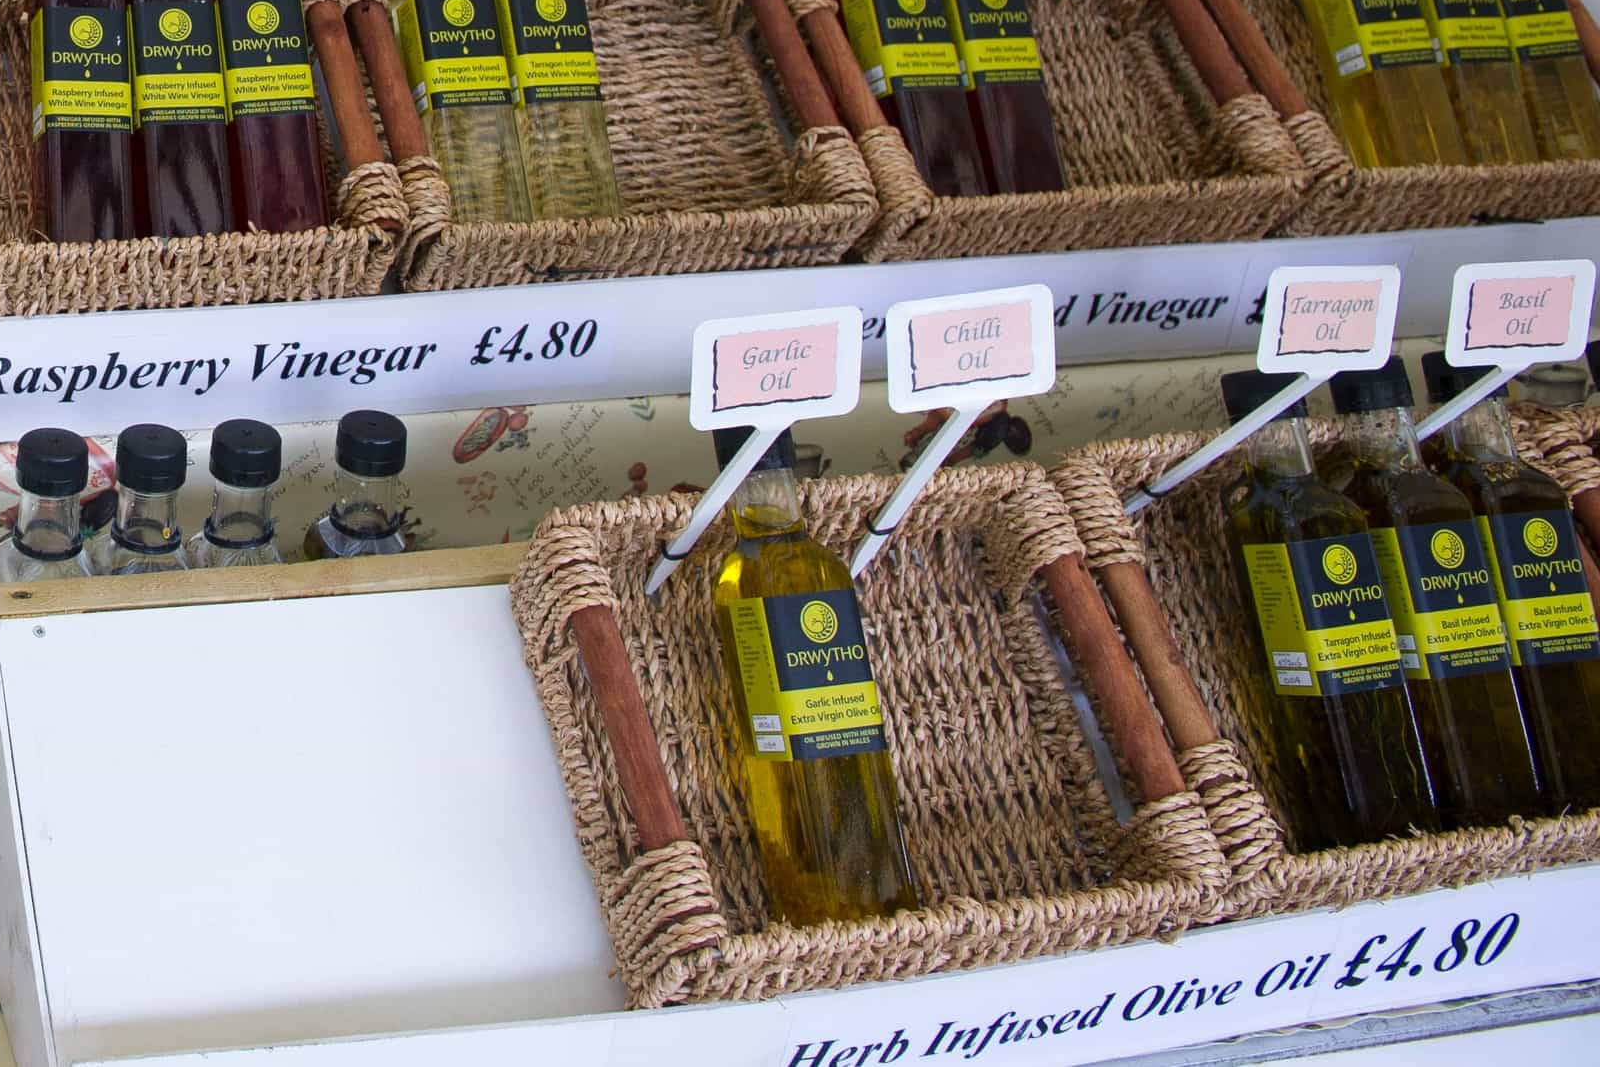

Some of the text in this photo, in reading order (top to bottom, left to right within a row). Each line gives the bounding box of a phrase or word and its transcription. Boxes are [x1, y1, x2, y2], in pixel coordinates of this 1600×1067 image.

[145, 81, 216, 91] Raspberry Infused
[237, 72, 306, 84] Raspberry Infused
[52, 88, 124, 98] Raspberry Infused
[1290, 295, 1375, 320] Tarragon
[1499, 288, 1550, 310] Basil
[1087, 290, 1229, 332] Vinegar
[943, 318, 1003, 345] Chilli
[1315, 321, 1347, 341] Oil
[1506, 315, 1538, 336] Oil
[248, 339, 438, 385] Vinegar
[470, 318, 600, 366] £4.80
[742, 340, 811, 370] Garlic
[957, 346, 995, 371] Oil
[760, 368, 796, 391] Oil
[1534, 603, 1583, 616] Basil Infused
[1442, 615, 1490, 629] Basil Infused
[1518, 620, 1542, 630] Extra
[1543, 618, 1567, 629] Virgin
[1324, 630, 1391, 647] Tarragon Infused
[1427, 634, 1450, 644] Extra
[1451, 631, 1475, 642] Virgin
[1318, 651, 1341, 662] Extra
[1342, 647, 1367, 658] Virgin
[805, 694, 865, 709] Garlic Infused
[791, 708, 869, 725] Extra Virgin Olive
[788, 912, 1520, 1067] Herb Infused Olive Oil £4.80
